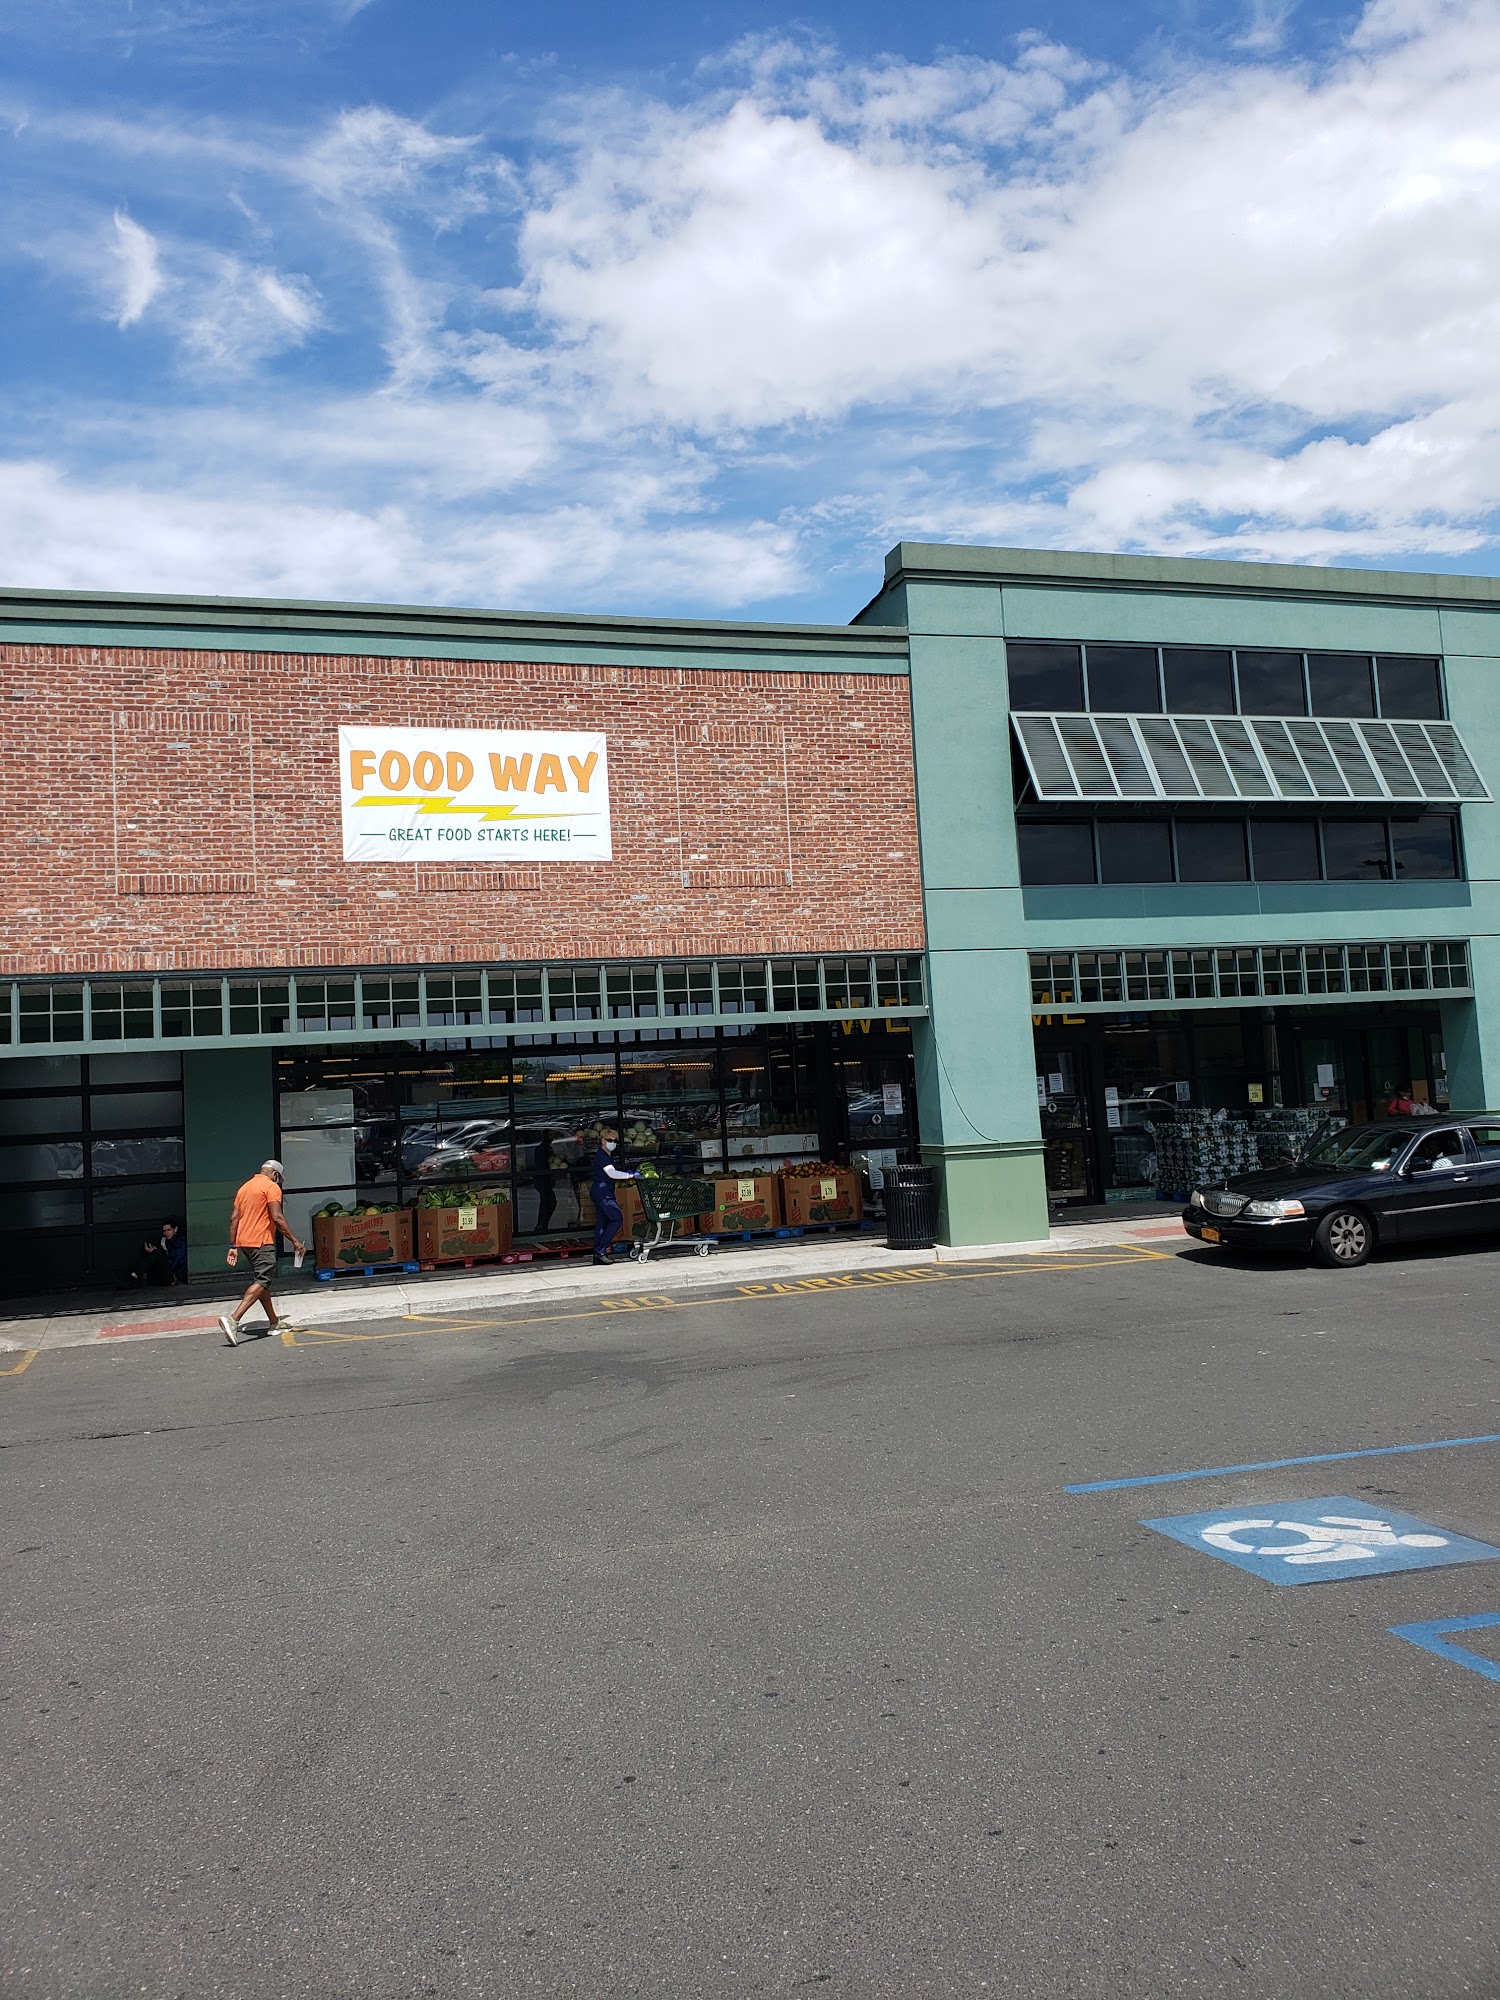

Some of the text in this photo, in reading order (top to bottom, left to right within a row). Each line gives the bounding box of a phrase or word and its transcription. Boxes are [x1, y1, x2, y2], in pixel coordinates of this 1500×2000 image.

[350, 750, 599, 794] FOOD WAY
[389, 828, 571, 841] GREAT FOOD STARTS HERE!
[599, 1268, 950, 1310] NO PARKING
